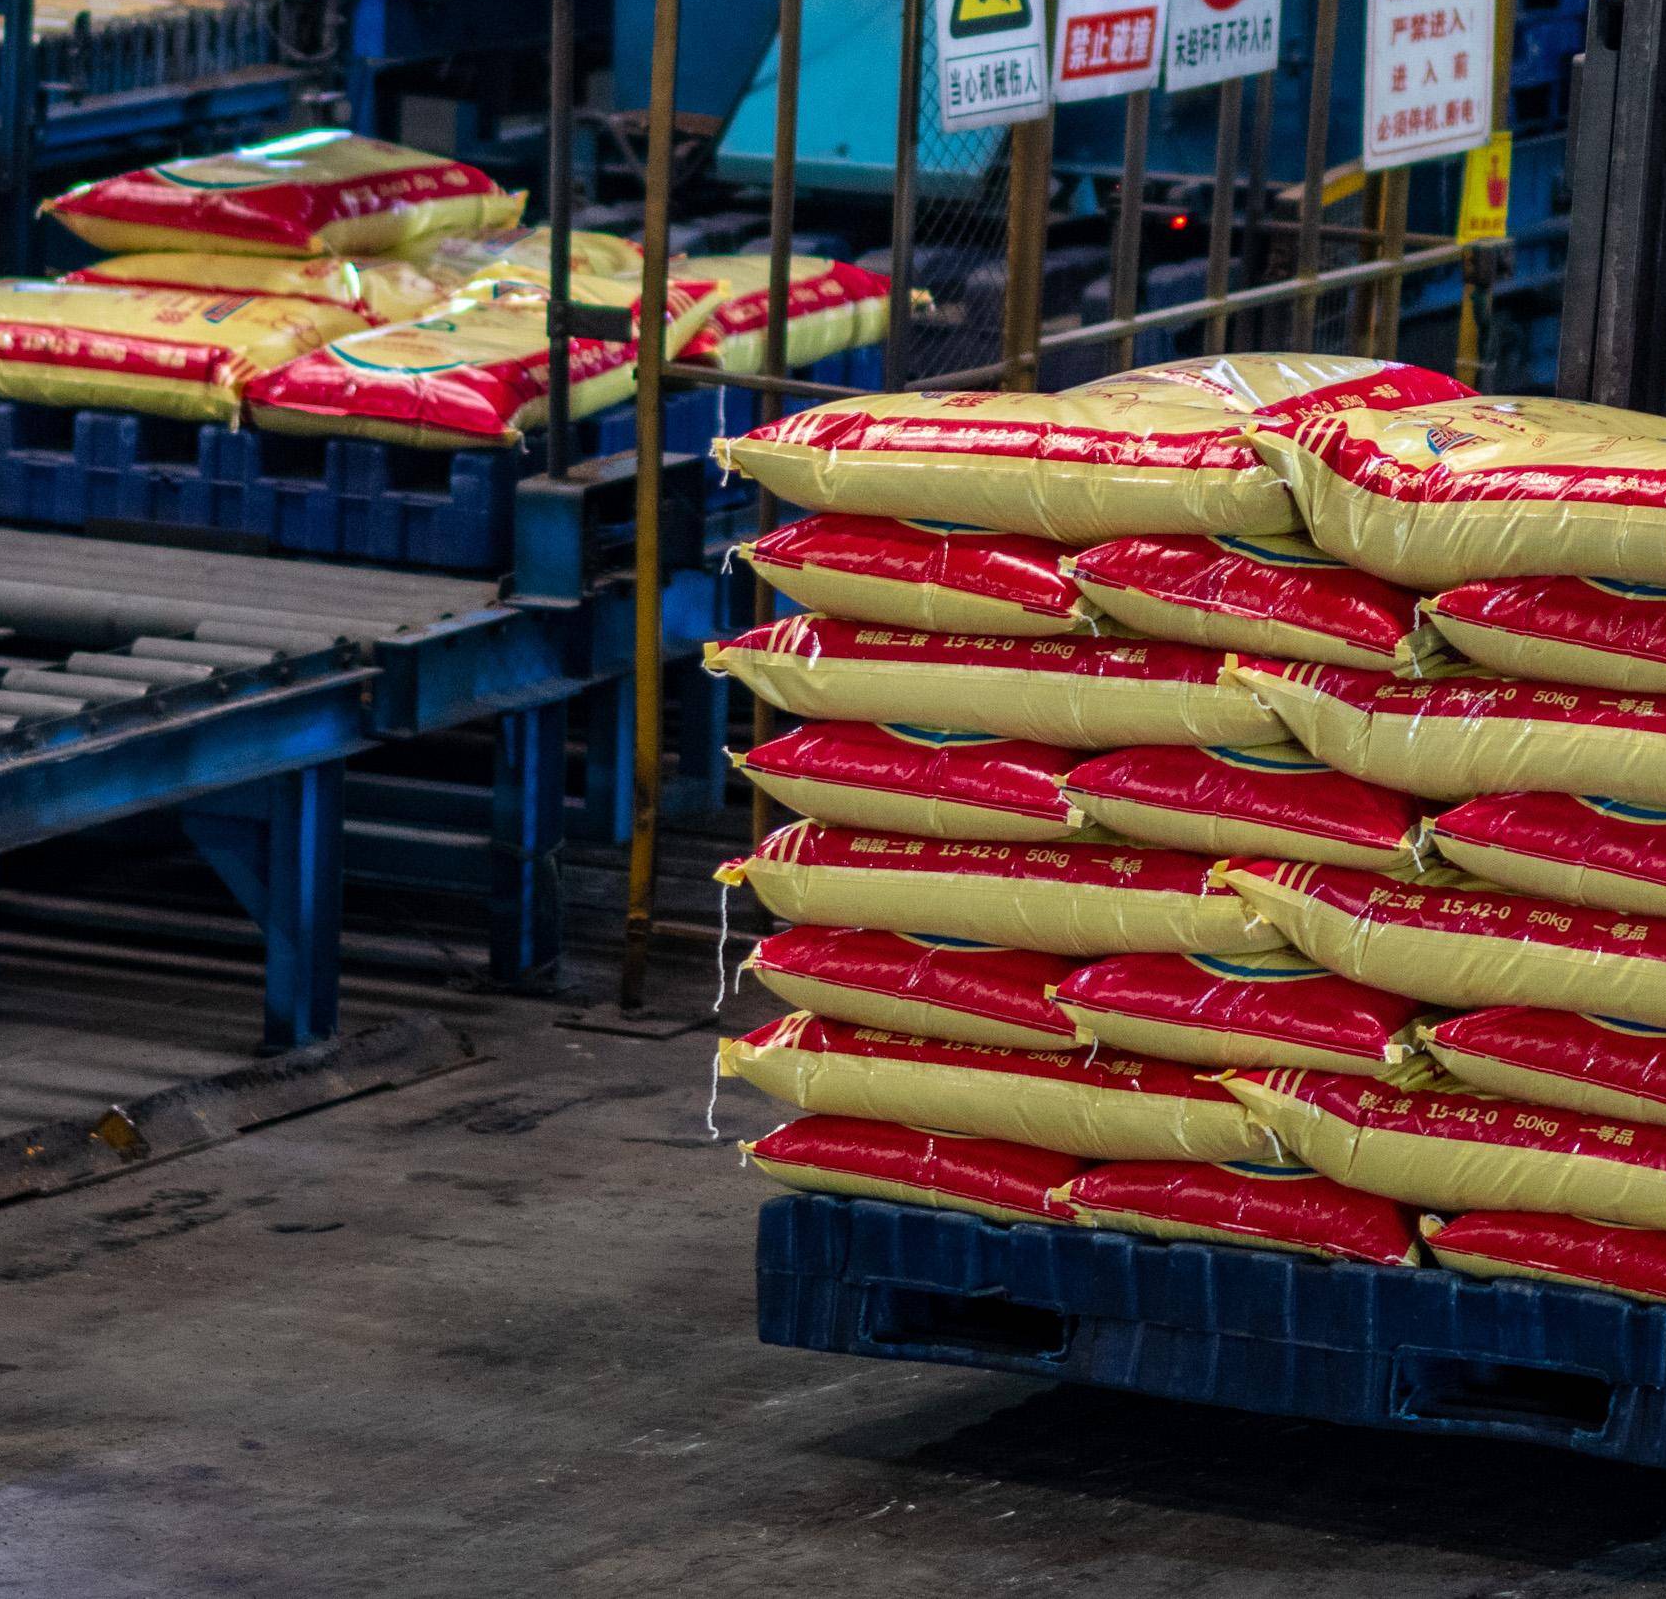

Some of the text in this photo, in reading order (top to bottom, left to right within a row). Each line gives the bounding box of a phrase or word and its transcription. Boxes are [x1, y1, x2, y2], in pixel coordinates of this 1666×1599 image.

[949, 56, 1038, 107] 当心机械伤人
[1333, 392, 1368, 411] 50kg
[854, 629, 930, 648] 磷酸二铵
[942, 635, 1016, 651] 15-42-0
[1030, 640, 1076, 660] 50kg
[1532, 689, 1580, 710] 50kg
[1598, 698, 1656, 717] 一等品
[849, 836, 1145, 875] 磷酸二铵 15-42-0 50kg 一等品
[1438, 898, 1512, 921] 15-42-0
[1526, 909, 1574, 933] 50kg
[1592, 922, 1650, 943] 一等品
[1027, 1050, 1073, 1069] 50kg
[1426, 1101, 1499, 1126] 15-42-0
[1512, 1112, 1560, 1138] 50kg
[1578, 1124, 1636, 1148] 一等品
